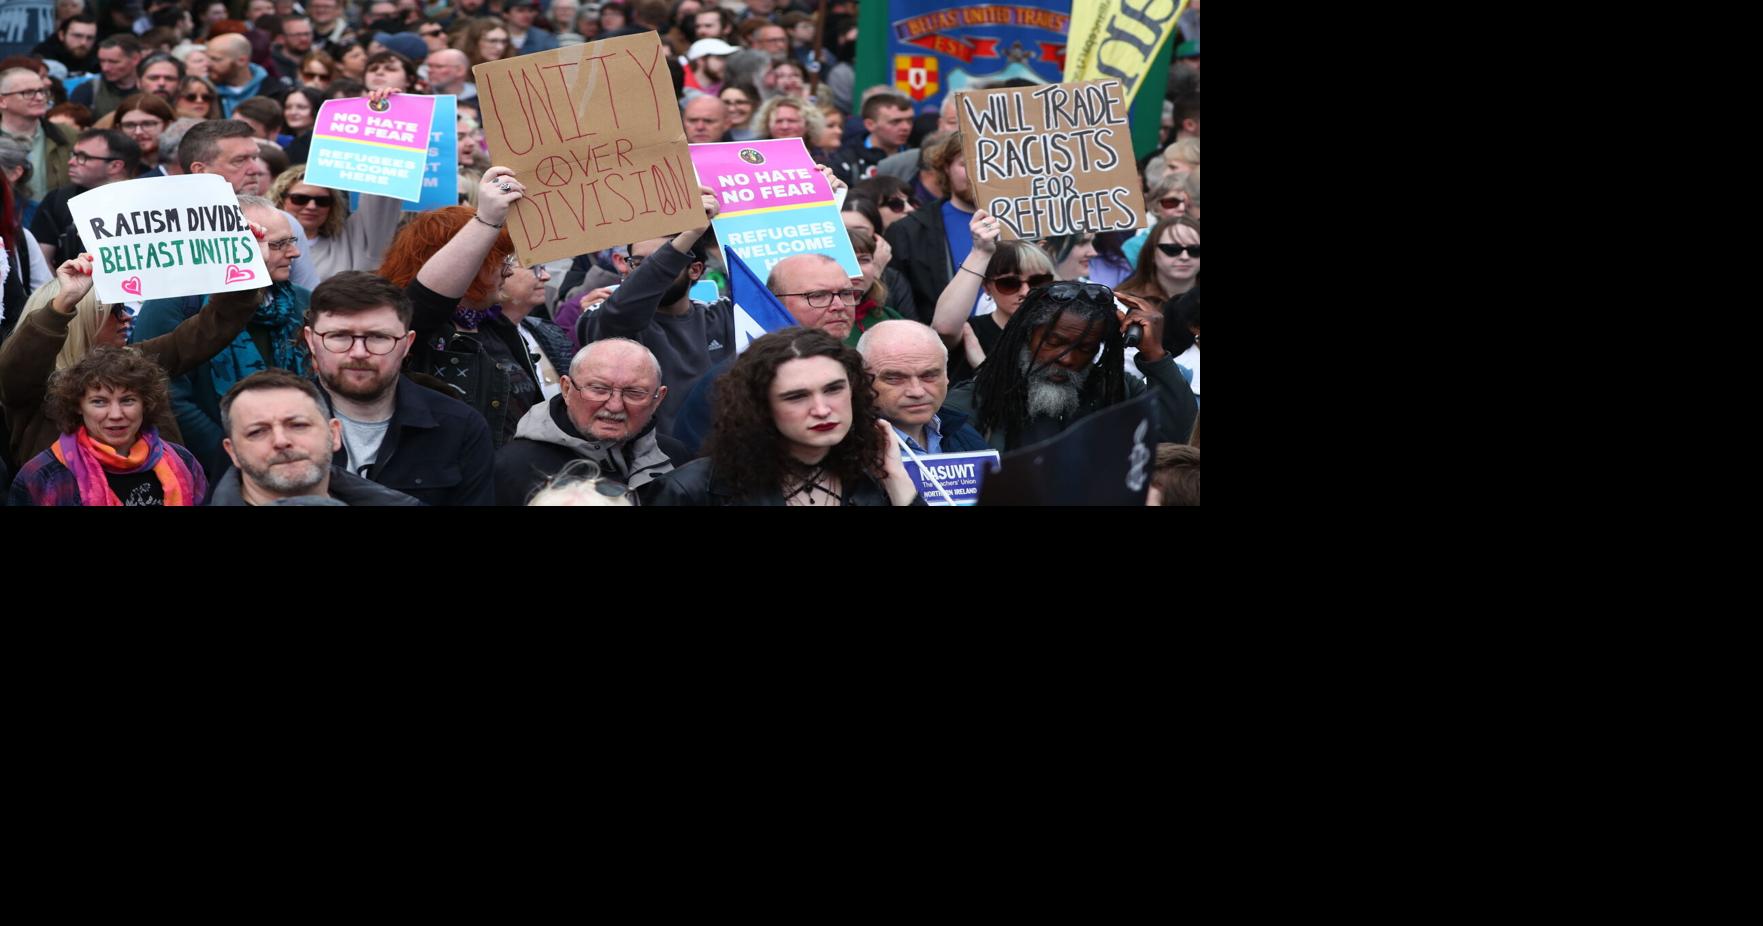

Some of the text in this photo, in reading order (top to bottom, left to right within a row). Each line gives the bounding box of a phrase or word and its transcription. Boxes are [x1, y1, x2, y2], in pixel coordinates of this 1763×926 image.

[485, 44, 661, 156] UNITY
[963, 80, 1126, 136] WILL TRADE
[329, 122, 359, 134] NO
[363, 126, 415, 143] FEAR
[332, 112, 419, 133] NO HATE
[318, 148, 417, 170] REFUGEES
[535, 138, 634, 187] OVER
[976, 127, 1119, 182] RACISTS
[317, 157, 410, 178] WELCOME
[339, 171, 390, 185] HERE
[717, 168, 812, 187] NO HATE
[721, 182, 816, 204] NO FEAR
[1031, 174, 1079, 199] FOR
[514, 154, 693, 251] DIVISION
[989, 187, 1137, 239] REFUGEES
[89, 208, 181, 240] RACISM
[727, 221, 836, 246] REFUGEES
[98, 236, 254, 274] BELFAST UNITES
[735, 236, 836, 259] WELCOME
[919, 463, 975, 481] NASUWT
[954, 488, 978, 496] IRELAND
